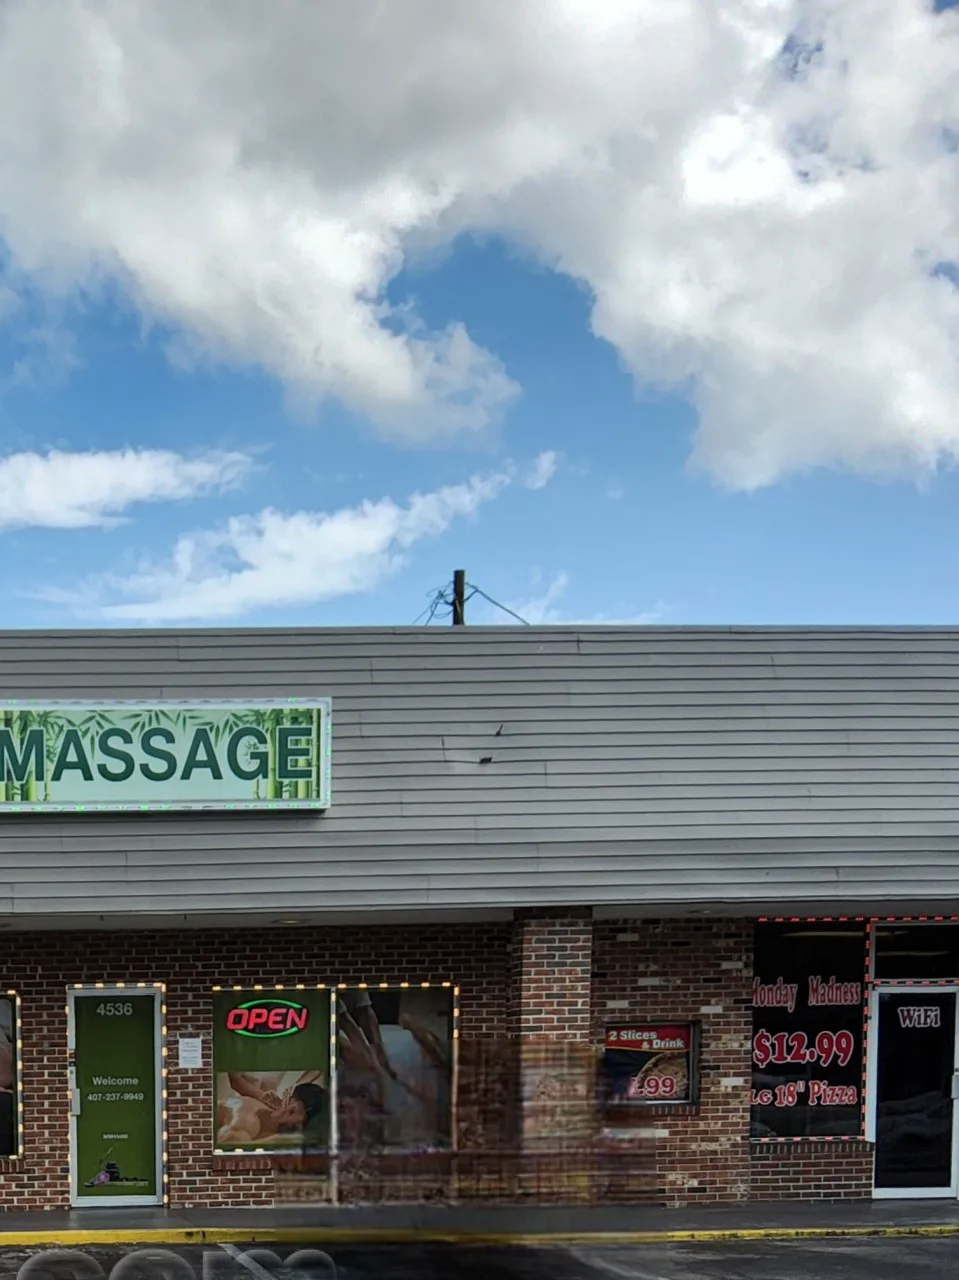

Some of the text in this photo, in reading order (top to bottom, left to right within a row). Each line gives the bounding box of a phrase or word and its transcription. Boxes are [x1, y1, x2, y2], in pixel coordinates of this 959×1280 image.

[808, 975, 861, 1006] Madness
[96, 1003, 133, 1016] 4536
[227, 1008, 308, 1030] OPEN
[897, 1006, 940, 1028] WiFi
[608, 1030, 657, 1041] 2 Slices
[642, 1038, 685, 1049] & Drink
[753, 1029, 854, 1068] $12.99
[92, 1076, 139, 1086] Welcome
[808, 1080, 858, 1106] Pizza
